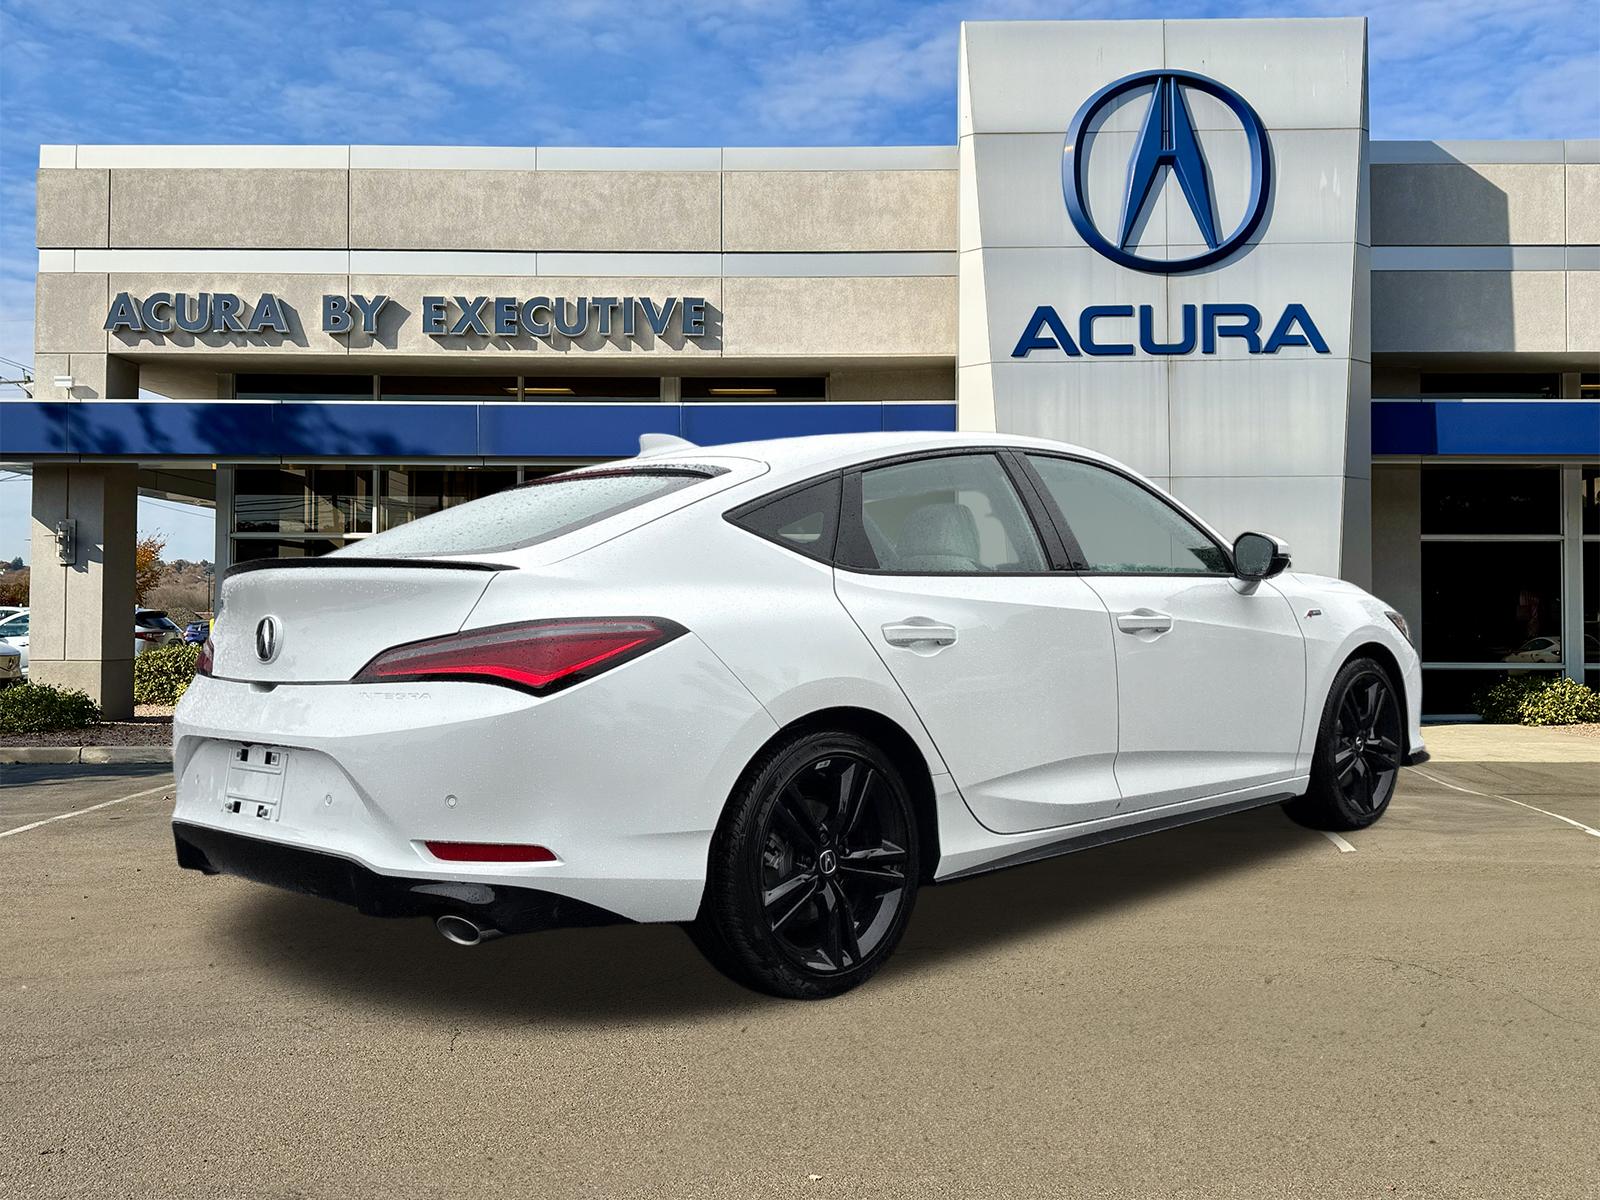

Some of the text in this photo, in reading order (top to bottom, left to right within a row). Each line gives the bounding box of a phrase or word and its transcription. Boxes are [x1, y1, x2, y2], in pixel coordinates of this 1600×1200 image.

[104, 291, 707, 337] ACURA BY EXECUTIVE
[1011, 303, 1332, 358] ACURA
